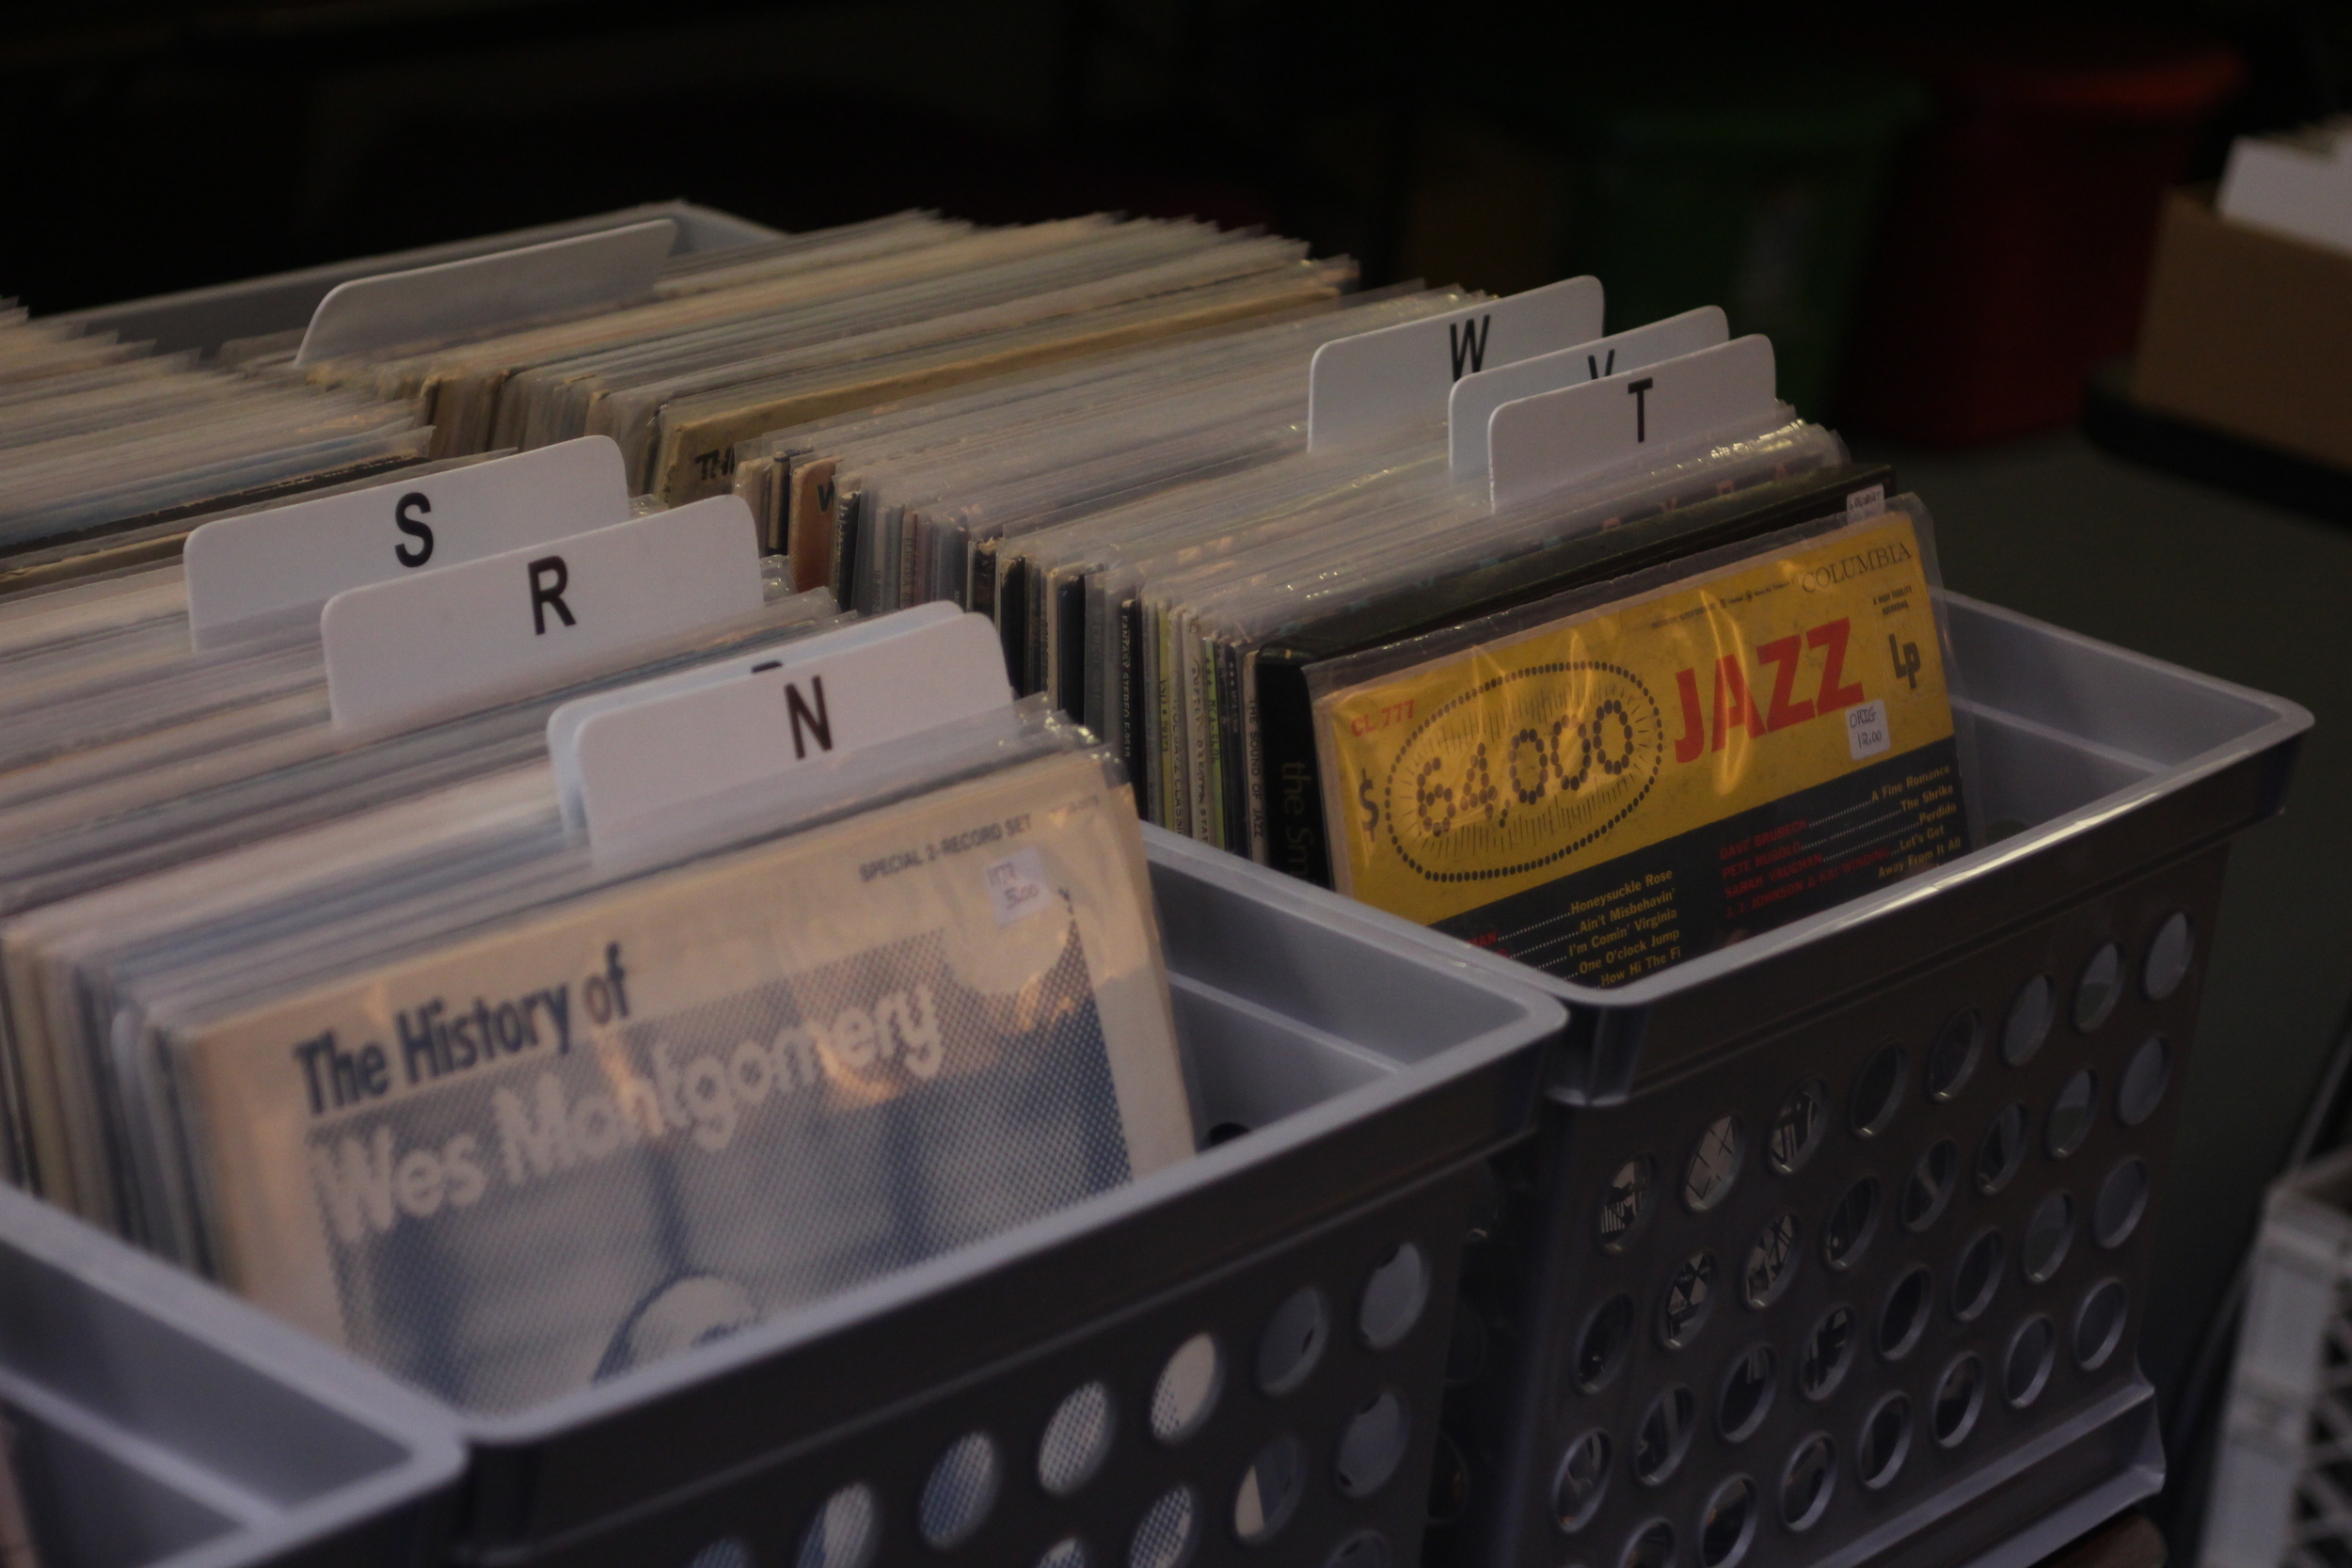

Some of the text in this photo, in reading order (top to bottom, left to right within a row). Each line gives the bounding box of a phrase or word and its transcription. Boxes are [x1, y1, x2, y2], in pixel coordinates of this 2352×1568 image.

[1449, 313, 1491, 380] W
[1628, 377, 1653, 443] T
[395, 492, 434, 568] S
[1801, 542, 1913, 594] COLUMBIA
[527, 555, 576, 636] R
[1675, 618, 1865, 764] JAZZ
[784, 674, 833, 759] N
[1350, 699, 1416, 737] CL 777
[1850, 707, 1877, 728] ORIG
[1857, 730, 1883, 749] 12.00
[1248, 699, 1264, 838] THE SOUND OF JAZZ
[1281, 761, 1311, 816] the
[1871, 765, 1951, 803] A Fine Romance
[1899, 784, 1954, 813] The Shrike
[1918, 801, 1958, 826] Perdido
[858, 849, 923, 883] SPECIAL
[1005, 813, 1032, 837] SET
[1719, 818, 1808, 861] DAVE BRUBECK
[1722, 841, 1803, 879] PETE RUGOLO
[1877, 836, 1963, 880] Away From It All
[1899, 824, 1946, 852] Let's Get
[1570, 869, 1673, 915] Honeysuckle Rose
[1724, 852, 1823, 899] SARAH VAUGHAN
[1751, 879, 1804, 910] JOHNSON
[1807, 876, 1817, 891] &
[1841, 847, 1892, 876] WINDING
[1568, 909, 1678, 958] I'm Comin' Virginia
[1579, 888, 1676, 934] Ain't Misbehavin'
[1579, 928, 1680, 974] One O'clock Jump
[1600, 945, 1682, 987] How Hi The Fi
[294, 942, 633, 1119] The History of
[313, 983, 942, 1243] Wes Montgomery
